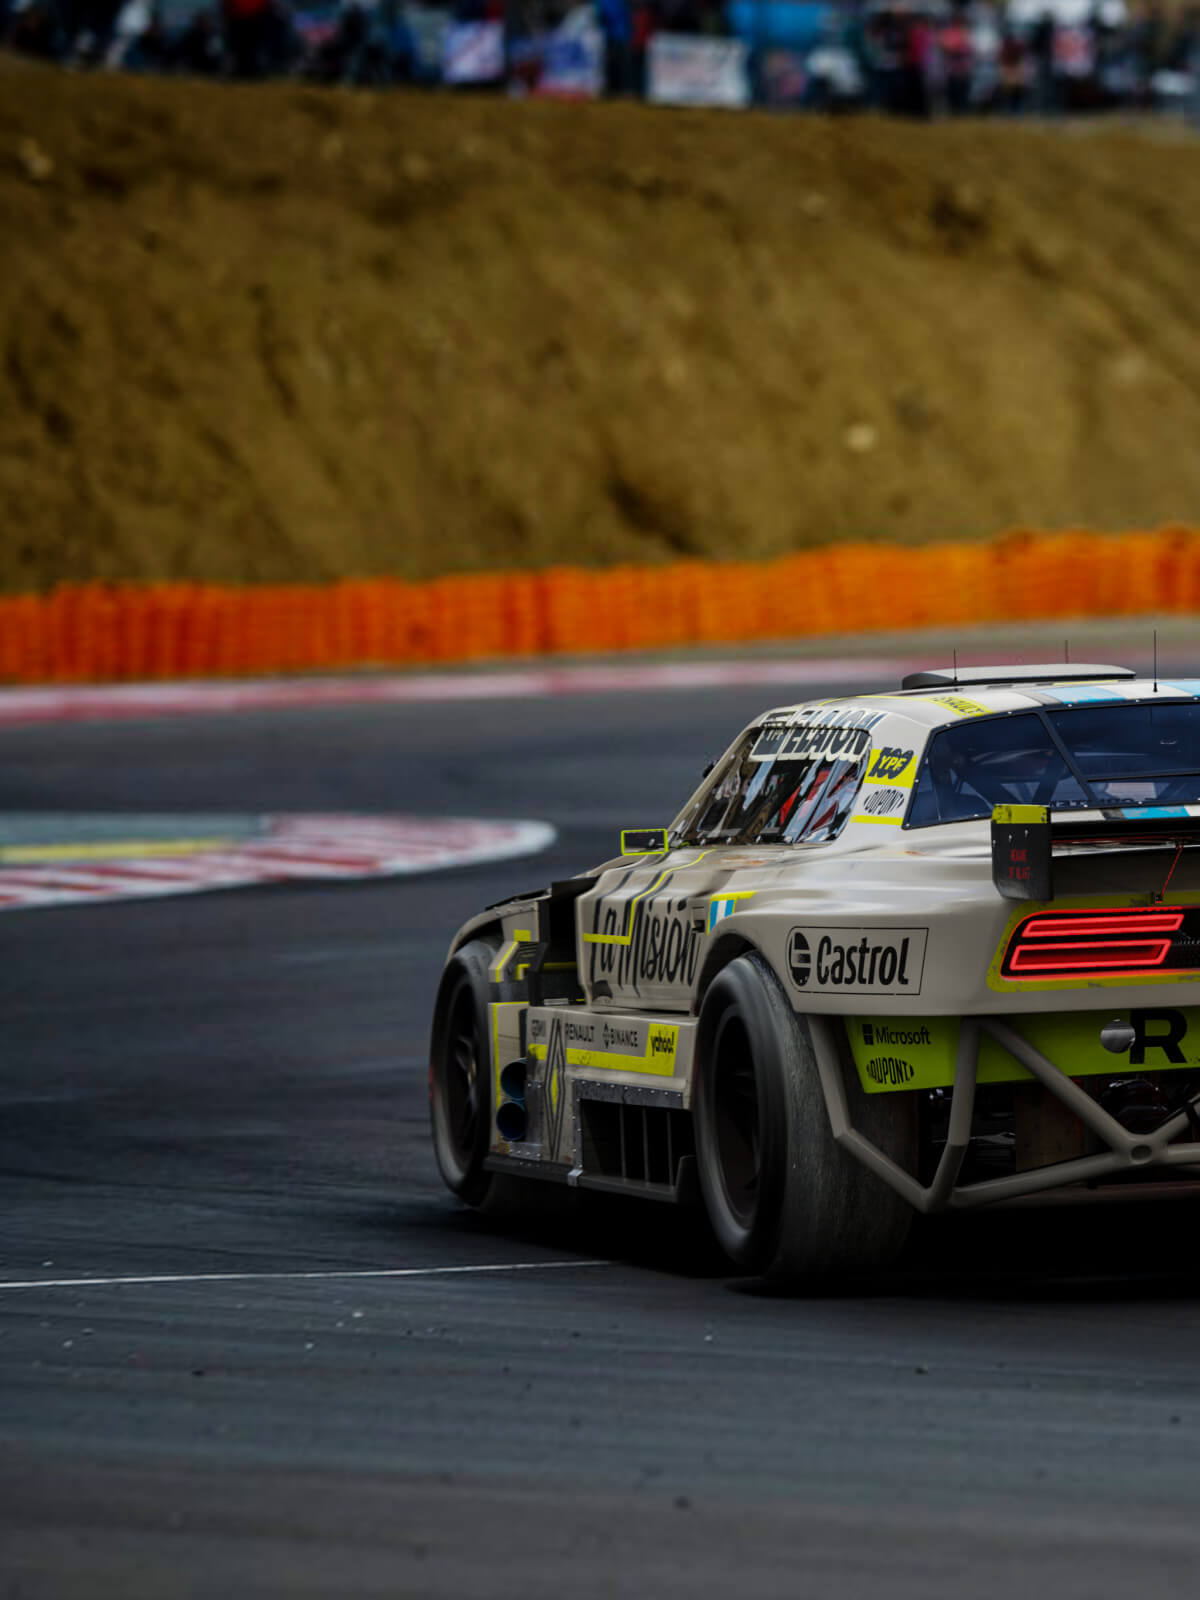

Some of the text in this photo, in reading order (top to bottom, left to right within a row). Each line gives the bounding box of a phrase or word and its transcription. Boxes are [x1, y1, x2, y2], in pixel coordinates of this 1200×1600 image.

[878, 755, 908, 771] YPF
[816, 935, 910, 986] Castrol
[565, 1022, 595, 1043] RENAULT
[610, 1027, 638, 1048] BINANCE
[876, 1026, 932, 1046] Microsoft
[650, 1031, 675, 1057] yahoo!
[867, 1056, 915, 1085] DUPONT
